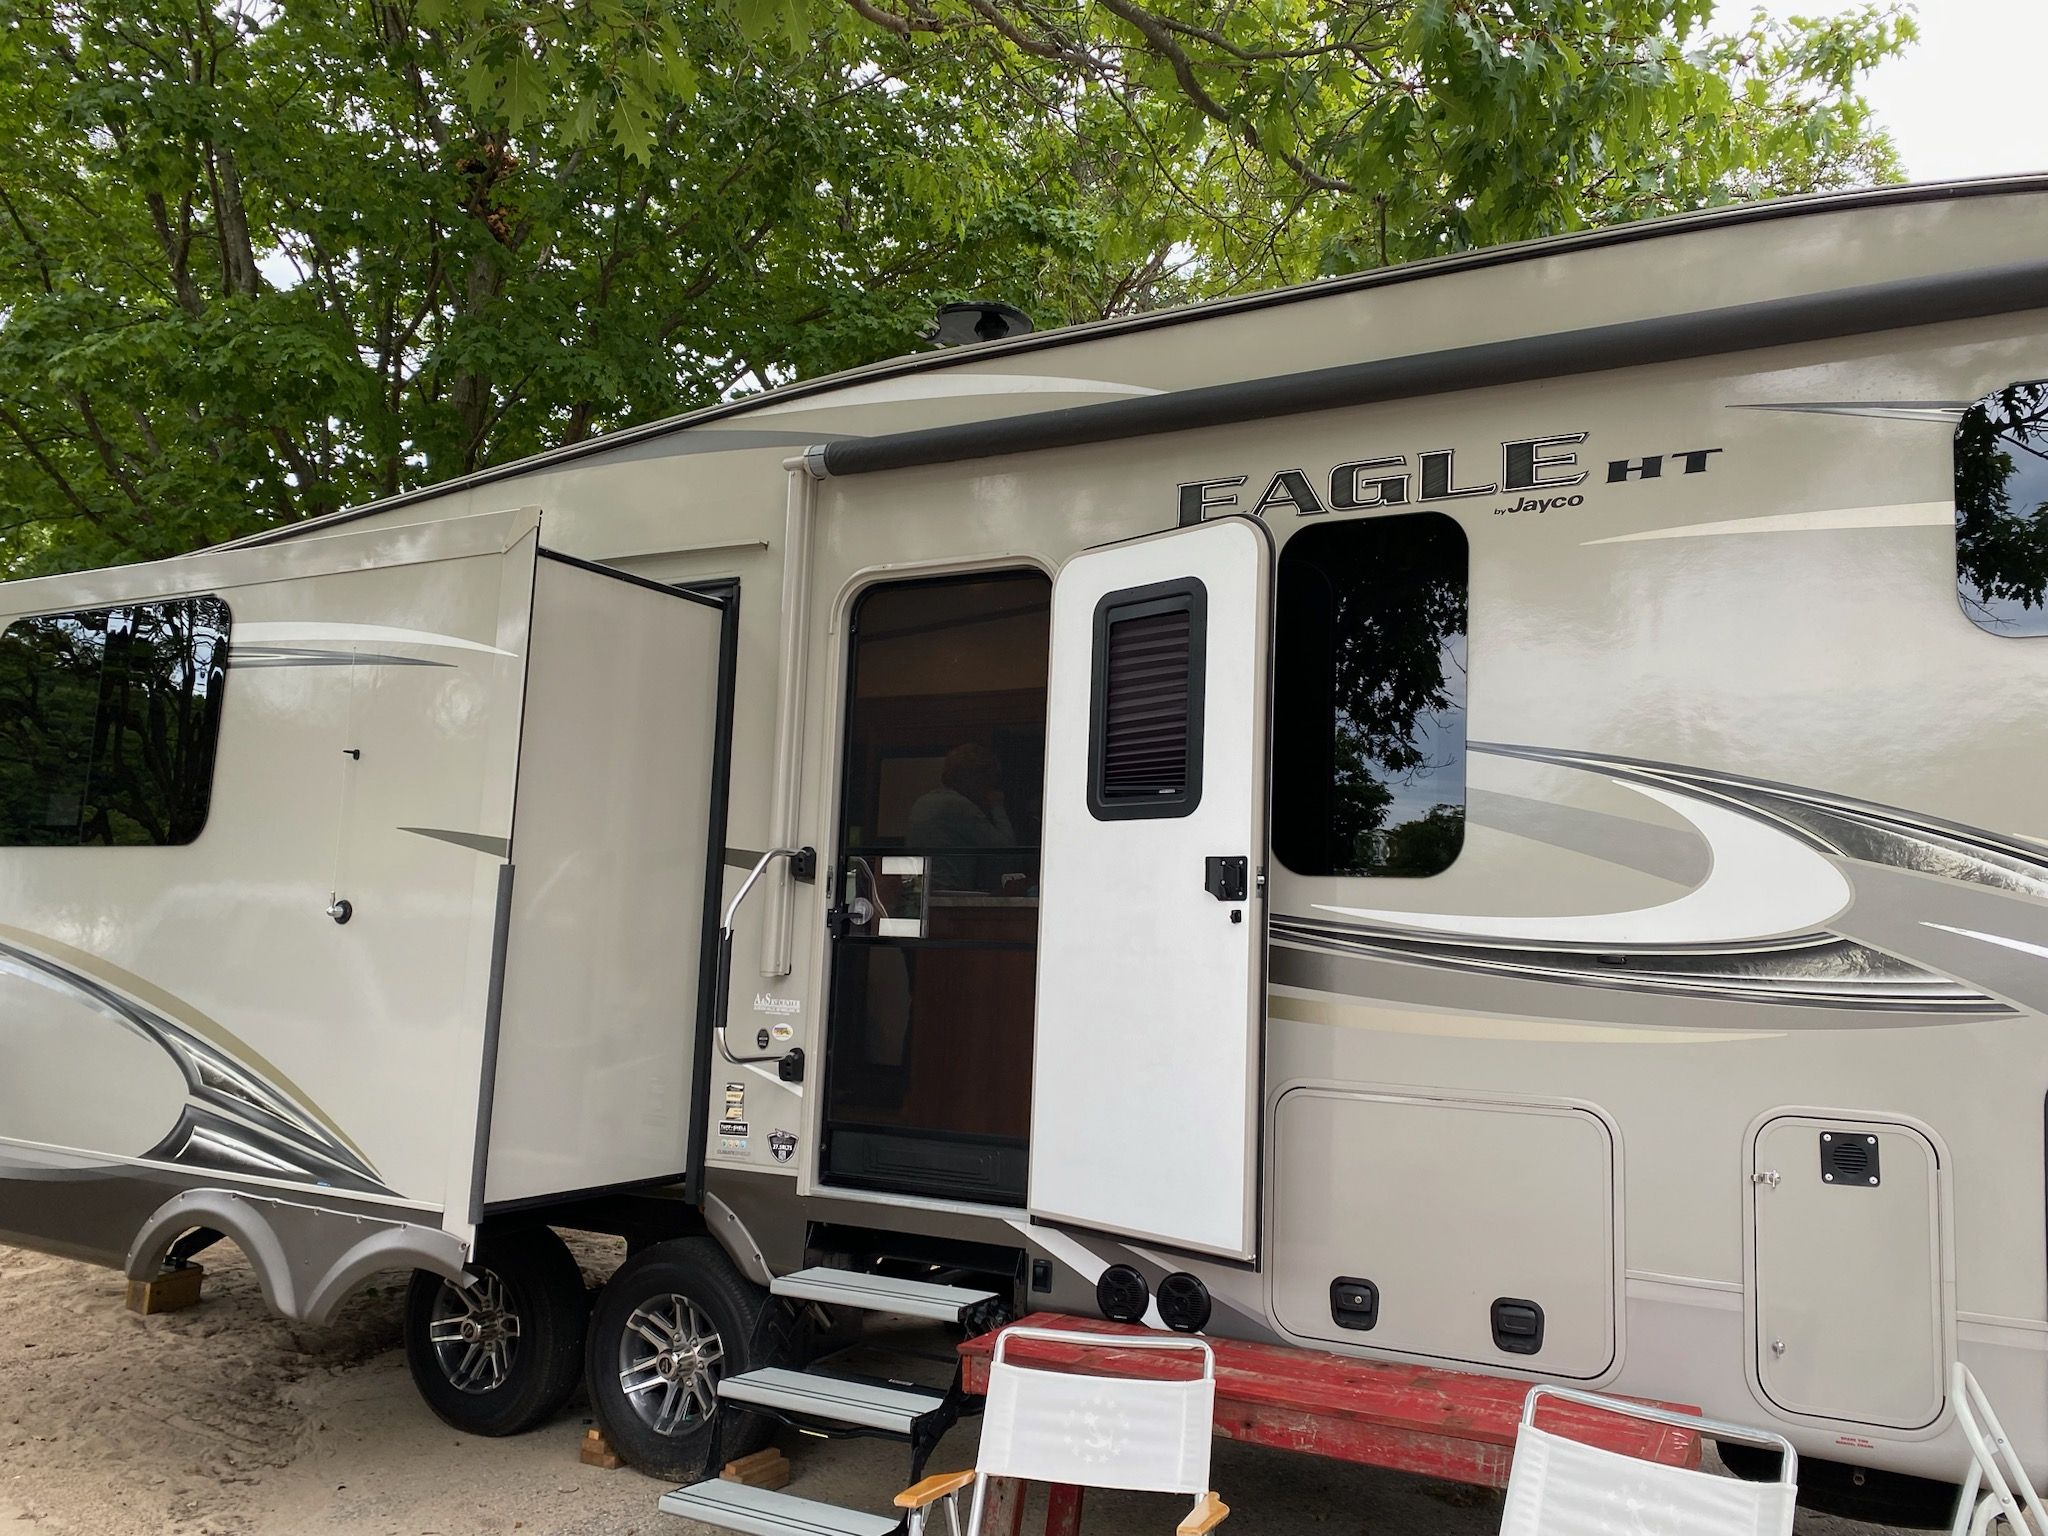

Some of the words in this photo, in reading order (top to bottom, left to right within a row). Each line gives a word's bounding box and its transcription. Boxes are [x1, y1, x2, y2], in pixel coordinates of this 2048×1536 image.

[1177, 431, 1589, 528] EAGLE
[1606, 448, 1723, 483] HT
[1507, 495, 1584, 514] Jayco
